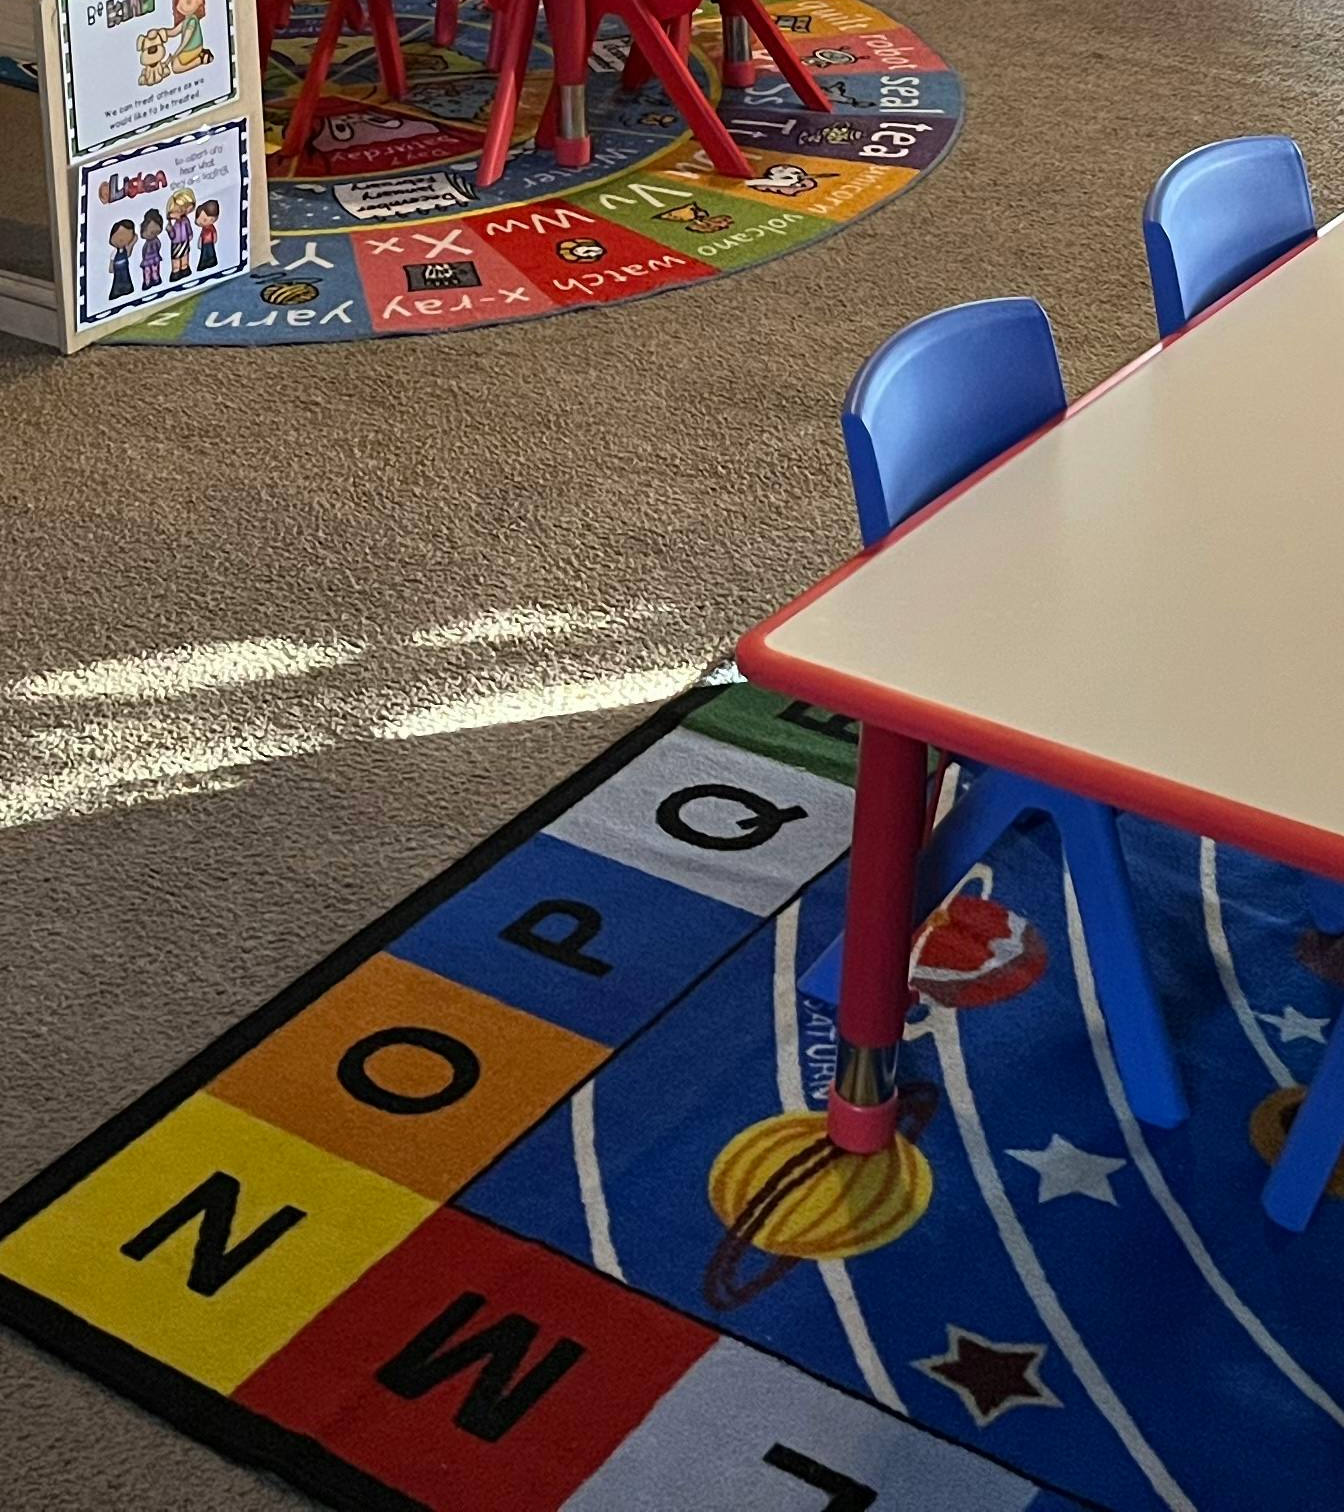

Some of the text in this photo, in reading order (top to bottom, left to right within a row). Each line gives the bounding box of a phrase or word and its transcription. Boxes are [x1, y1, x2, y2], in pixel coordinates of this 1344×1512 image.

[796, 0, 873, 32] quilt
[858, 34, 919, 71] robot
[879, 75, 946, 115] seal
[858, 122, 933, 160] tea
[357, 192, 457, 213] December
[599, 183, 693, 210] Vv
[370, 229, 474, 257] Xx
[486, 209, 595, 238] Ww
[697, 211, 804, 258] volcano
[552, 255, 687, 296] watch
[204, 299, 354, 329] yarn
[381, 286, 531, 321] x-ray
[657, 782, 808, 853] Q
[500, 899, 613, 977] P
[336, 1026, 482, 1114] O
[121, 1170, 307, 1296] N
[376, 1290, 585, 1442] M
[763, 1443, 878, 1512] L
